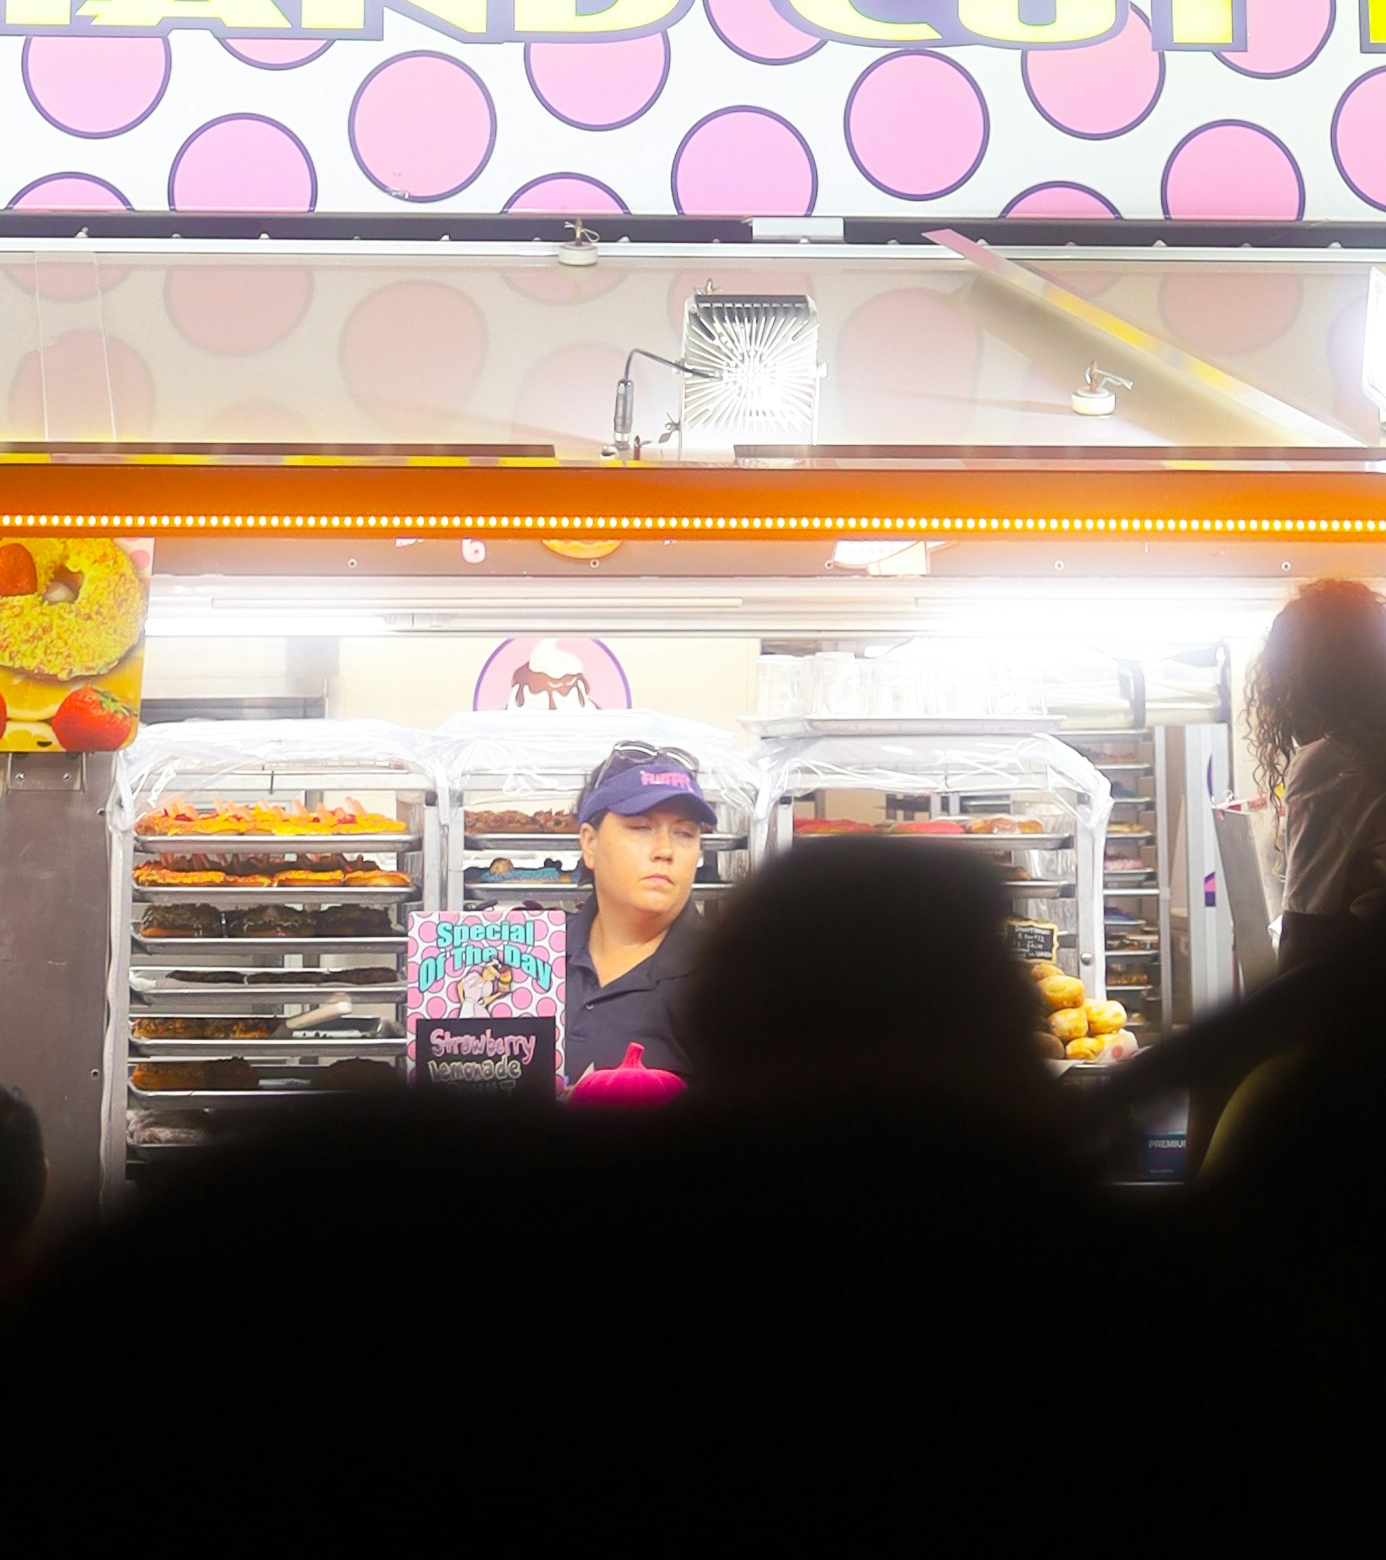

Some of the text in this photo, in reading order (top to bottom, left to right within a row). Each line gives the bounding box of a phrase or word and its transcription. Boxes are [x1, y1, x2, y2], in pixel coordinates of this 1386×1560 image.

[436, 920, 535, 948] Special
[418, 943, 552, 993] Of The Day
[430, 1028, 536, 1064] Strawberry
[428, 1056, 522, 1083] Lemonade
